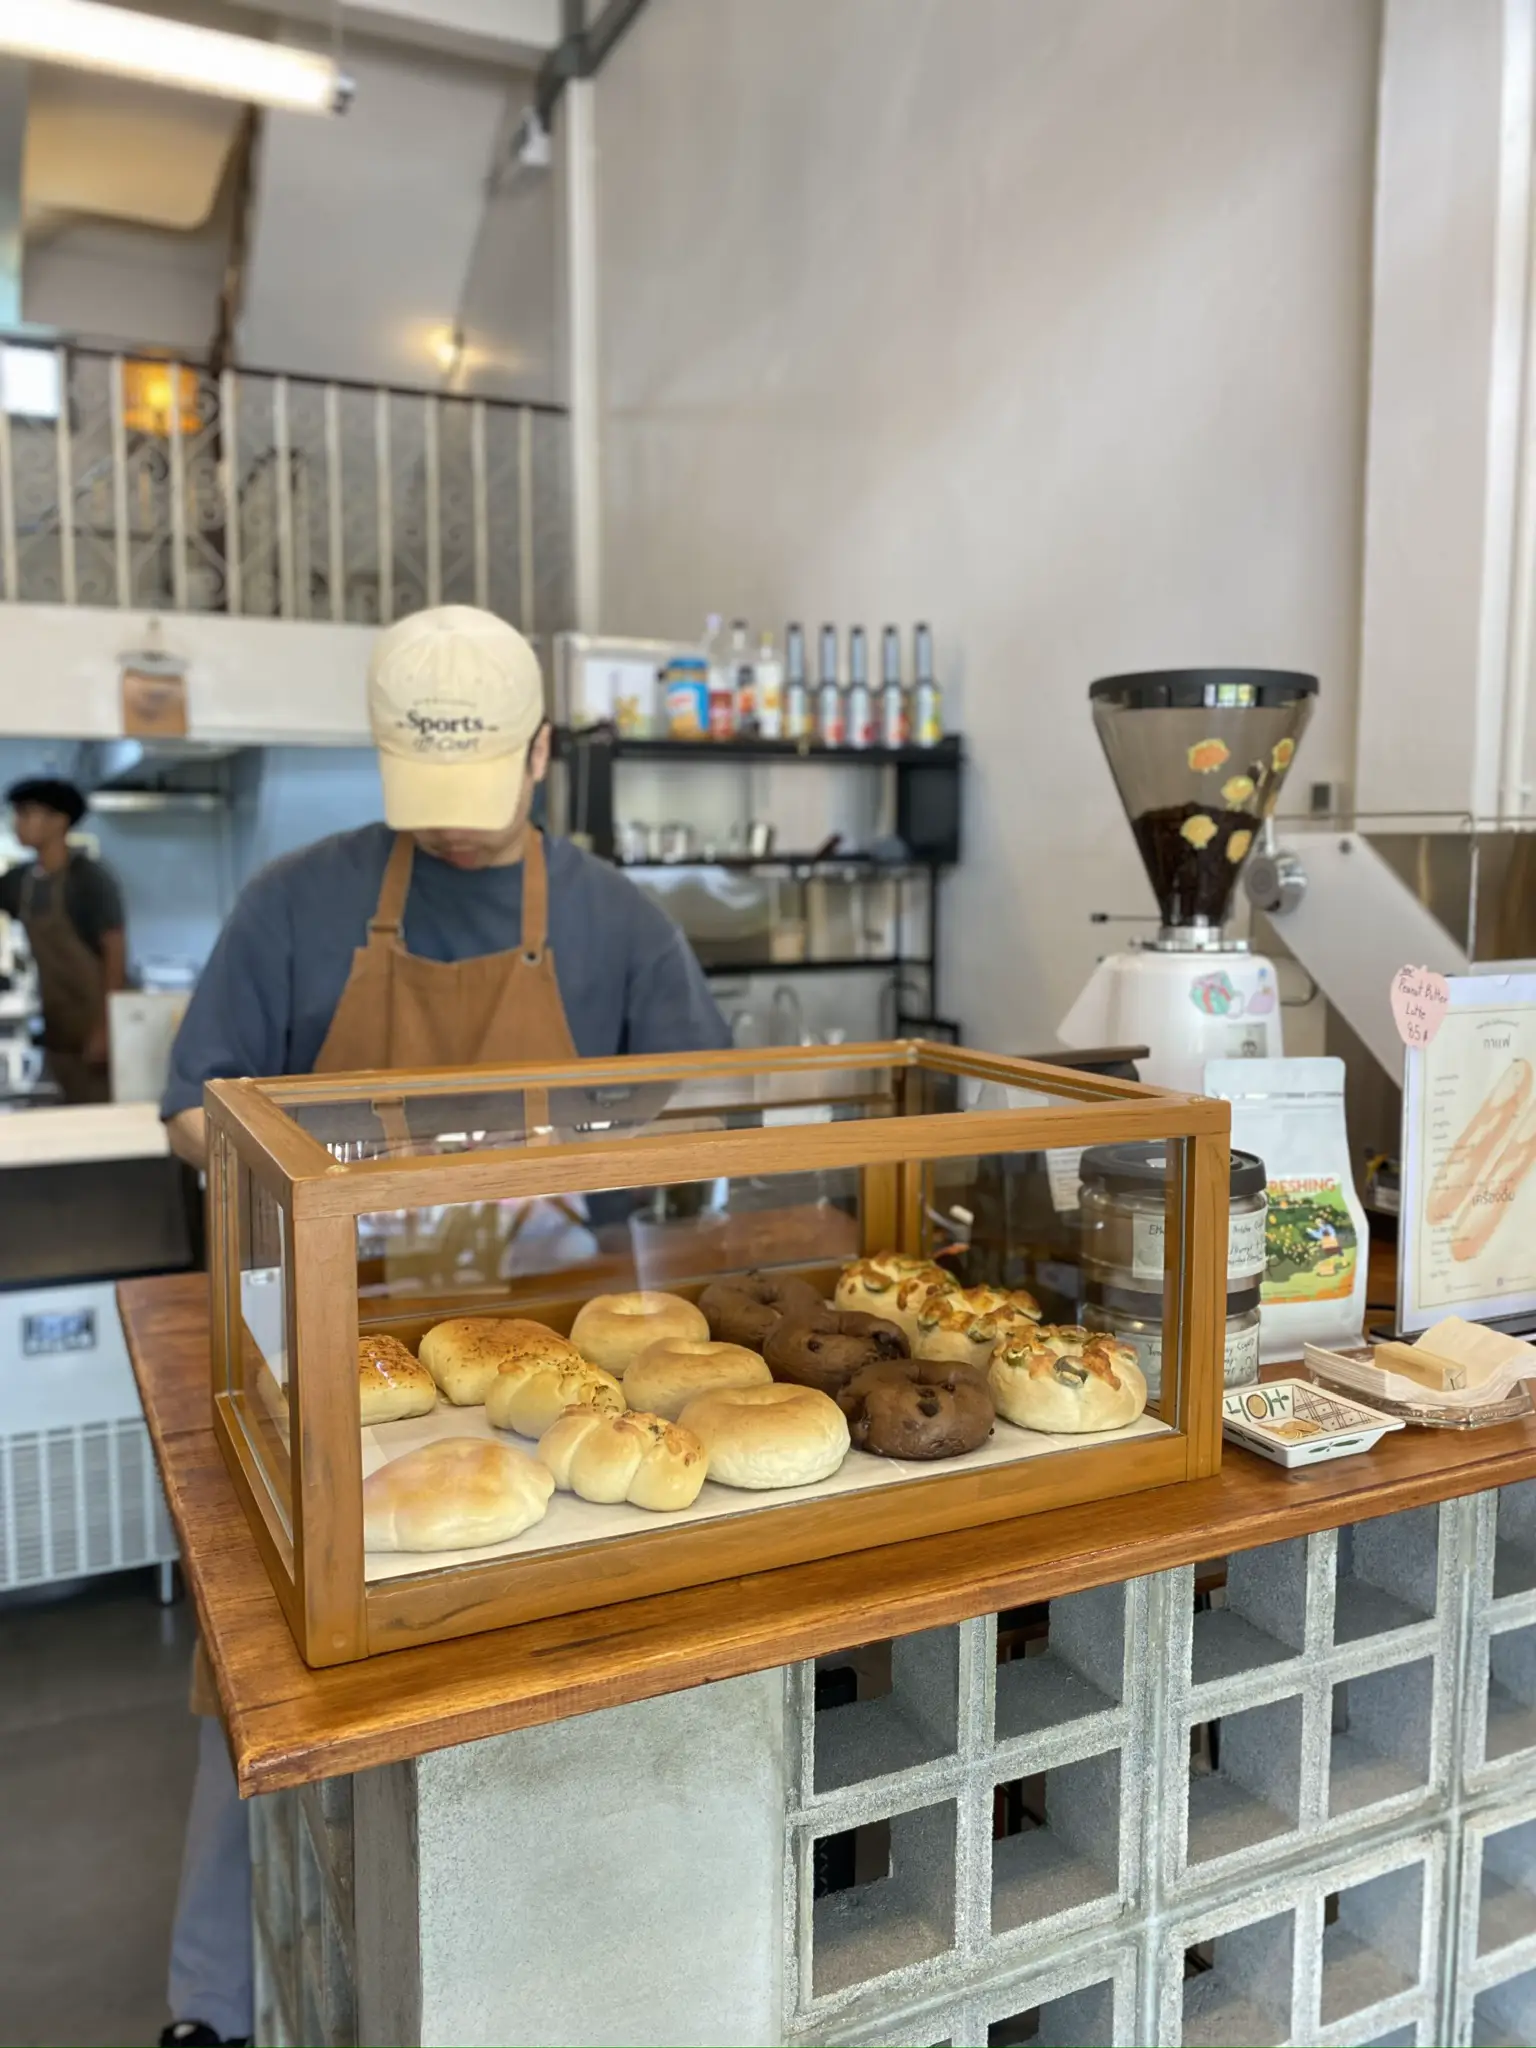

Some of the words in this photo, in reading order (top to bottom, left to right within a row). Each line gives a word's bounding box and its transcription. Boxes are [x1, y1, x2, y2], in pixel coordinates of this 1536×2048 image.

[405, 709, 484, 735] Sports
[1483, 1034, 1511, 1050] กาแฟ
[1268, 1177, 1336, 1193] RESHING
